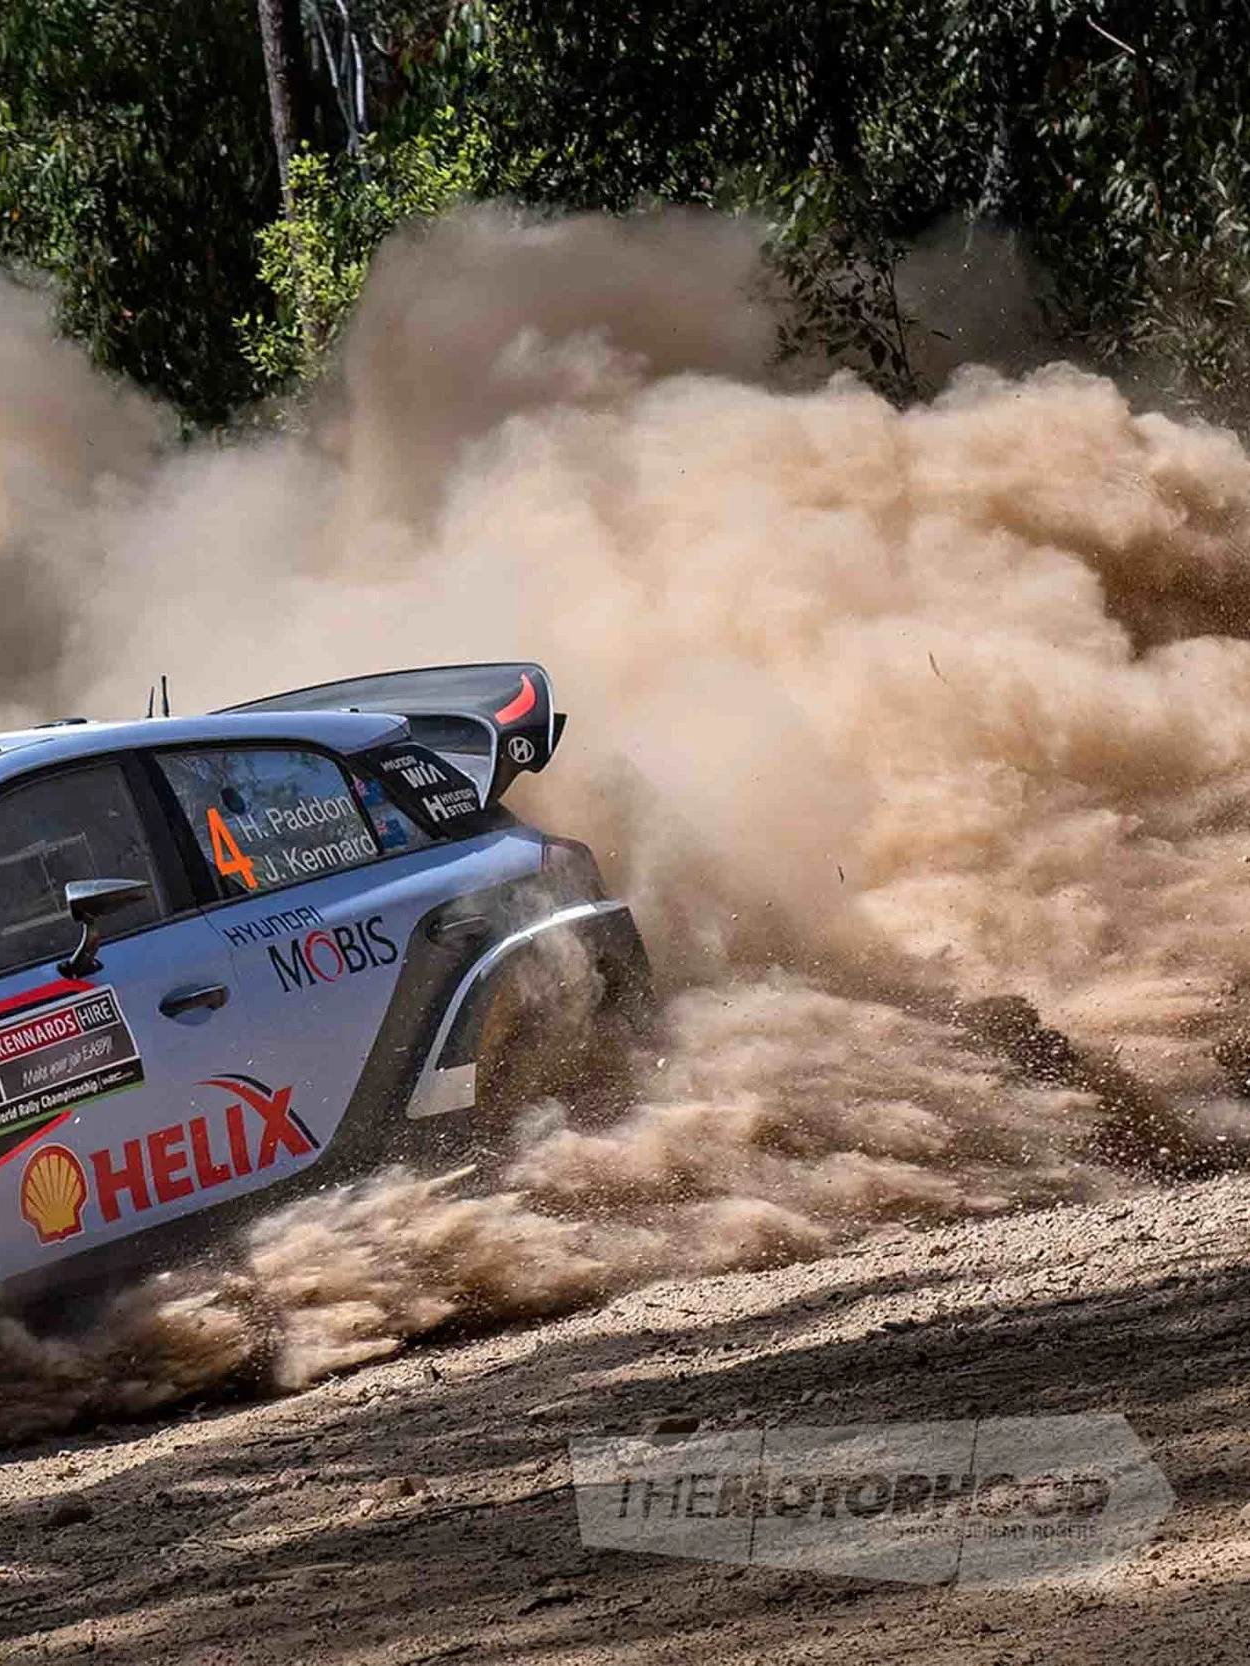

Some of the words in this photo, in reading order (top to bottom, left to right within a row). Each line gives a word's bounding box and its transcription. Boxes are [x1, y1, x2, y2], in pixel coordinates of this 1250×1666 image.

[380, 755, 418, 772] HYUNDAI
[401, 760, 448, 789] WIA
[440, 788, 476, 804] HYUNDAI
[446, 801, 477, 817] STEEL
[237, 810, 269, 843] H.
[265, 795, 356, 835] Paddon
[206, 807, 260, 889] 4
[264, 854, 287, 883] J.
[283, 827, 378, 876] Kennard
[223, 905, 325, 947] HYUNDAI
[266, 915, 399, 993] MOBIS
[77, 1000, 113, 1027] HIRE
[18, 1098, 40, 1116] Rally
[40, 1079, 98, 1108] Championship
[90, 1074, 322, 1225] HELIX
